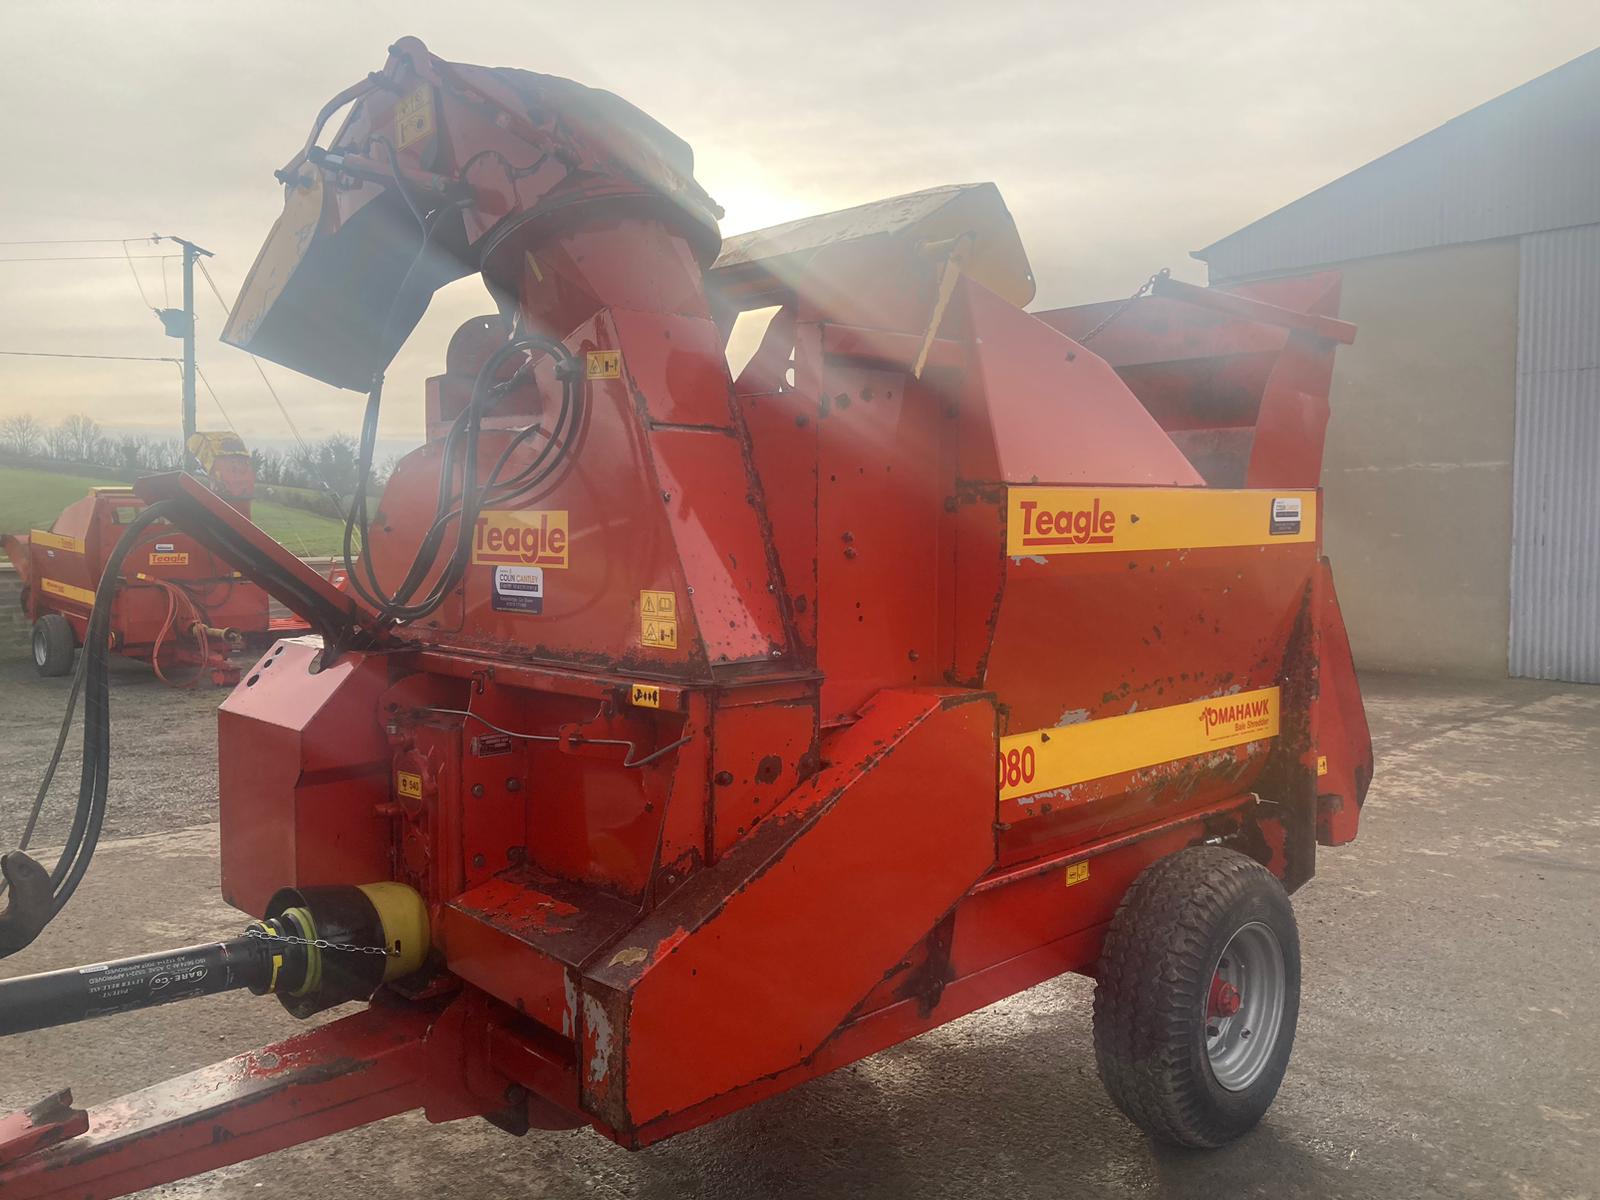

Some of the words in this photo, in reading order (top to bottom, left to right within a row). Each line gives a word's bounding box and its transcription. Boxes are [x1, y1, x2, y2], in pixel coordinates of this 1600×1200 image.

[475, 514, 566, 564] Teagle
[1020, 498, 1116, 544] Teagle
[152, 553, 187, 564] Teagle
[499, 573, 516, 582] COLIN
[1200, 699, 1270, 736] TOMAHAWK
